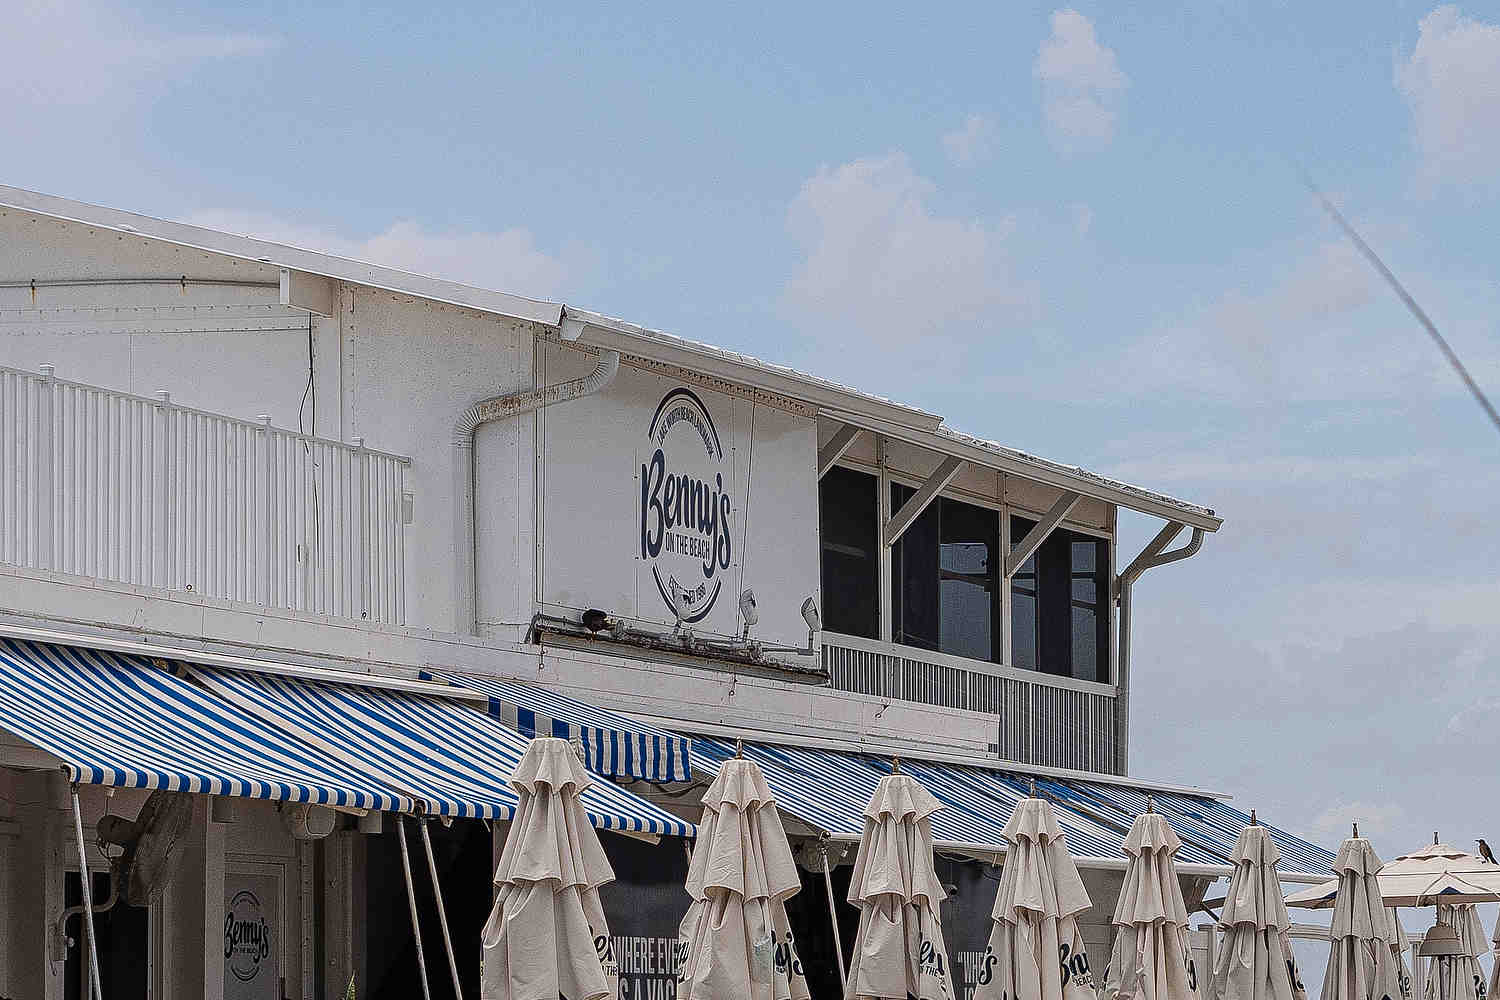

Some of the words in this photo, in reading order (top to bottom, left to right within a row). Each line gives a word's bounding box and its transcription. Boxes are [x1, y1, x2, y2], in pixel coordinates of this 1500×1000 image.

[641, 448, 731, 579] Benny's
[665, 531, 675, 553] ON
[676, 534, 688, 556] THE
[689, 536, 710, 561] BEACH
[224, 911, 269, 964] Benny's
